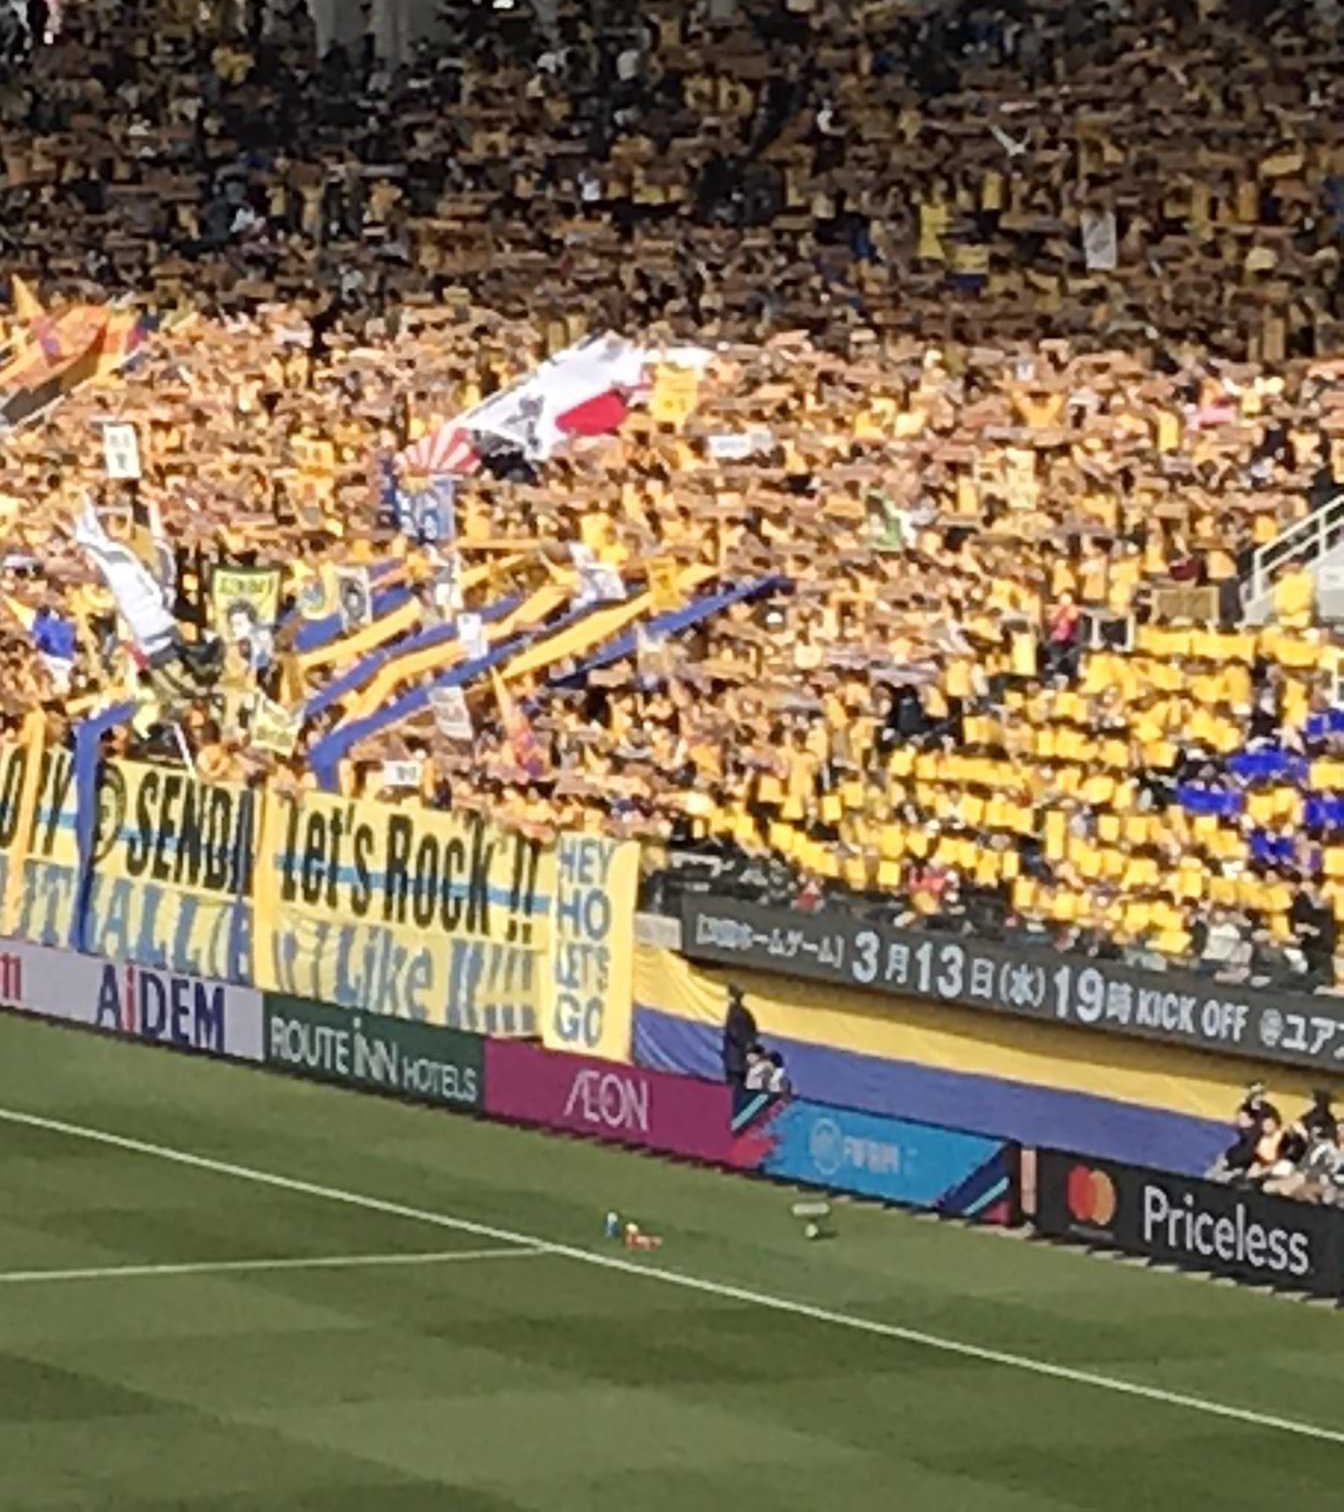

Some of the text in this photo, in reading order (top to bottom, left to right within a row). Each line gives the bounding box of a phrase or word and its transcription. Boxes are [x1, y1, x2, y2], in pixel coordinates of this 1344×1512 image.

[282, 790, 374, 918] Let's
[558, 837, 615, 885] HEY
[557, 888, 611, 942] HO
[554, 993, 606, 1047] GO
[270, 1016, 349, 1076] ROUTE
[402, 1054, 478, 1104] HOTELS
[1143, 1185, 1310, 1276] Priceless
